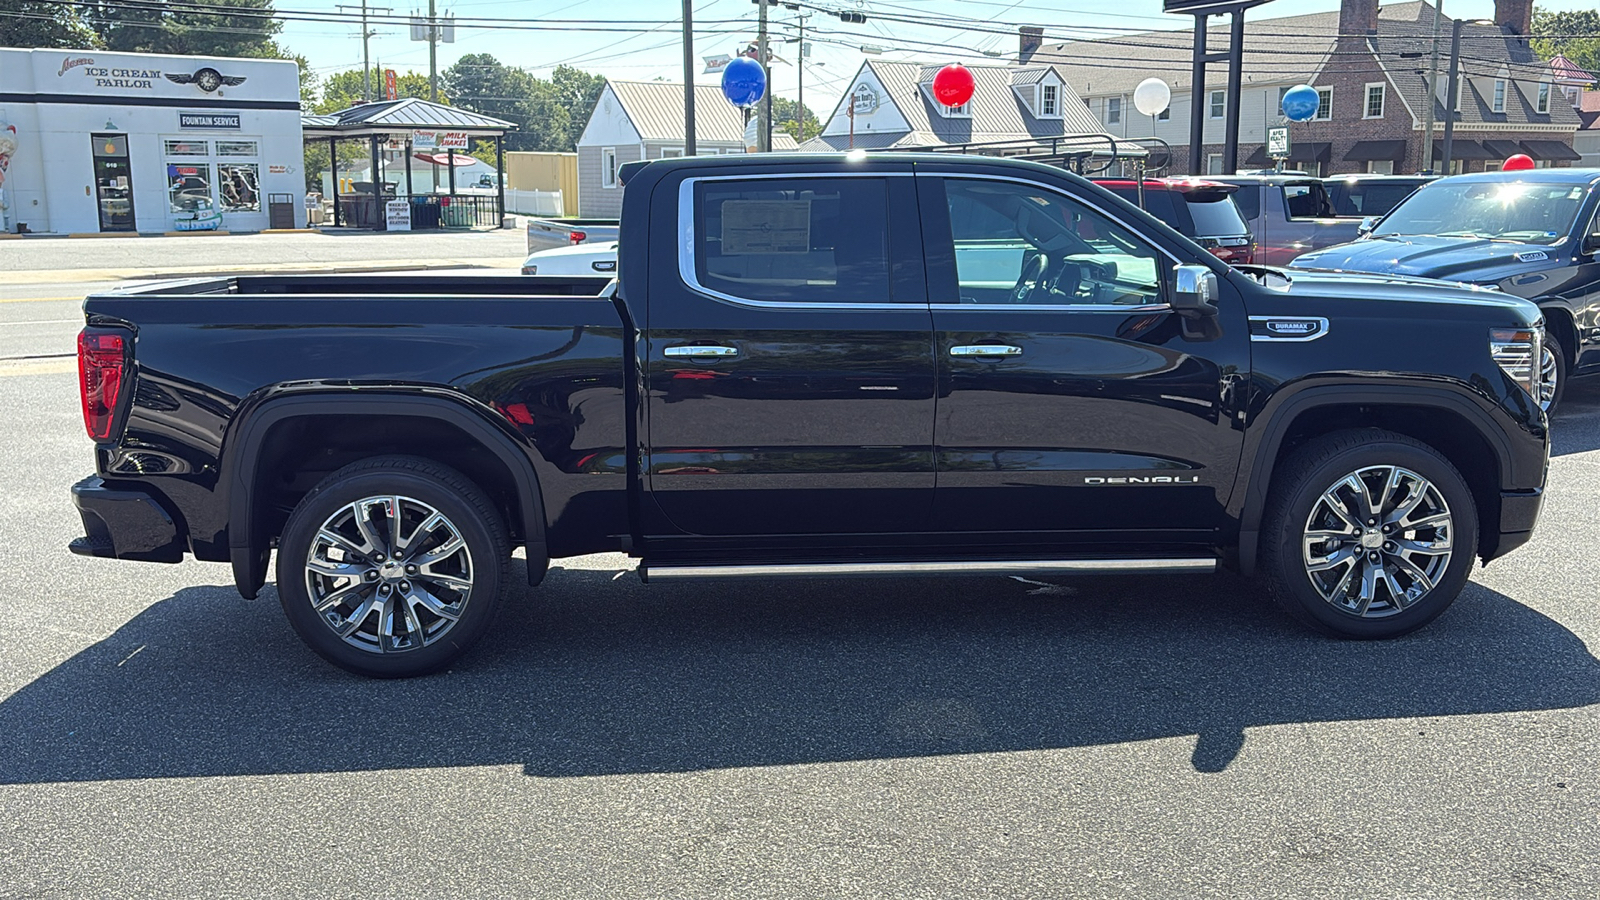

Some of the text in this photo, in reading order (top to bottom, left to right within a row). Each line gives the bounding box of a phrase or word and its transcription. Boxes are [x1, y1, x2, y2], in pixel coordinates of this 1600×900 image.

[58, 56, 94, 77] Acme
[86, 68, 161, 78] ICE CREAM
[96, 79, 152, 88] PARLOR
[182, 116, 239, 126] FOUNTAIN SERVICE
[1084, 476, 1199, 485] DENALI
